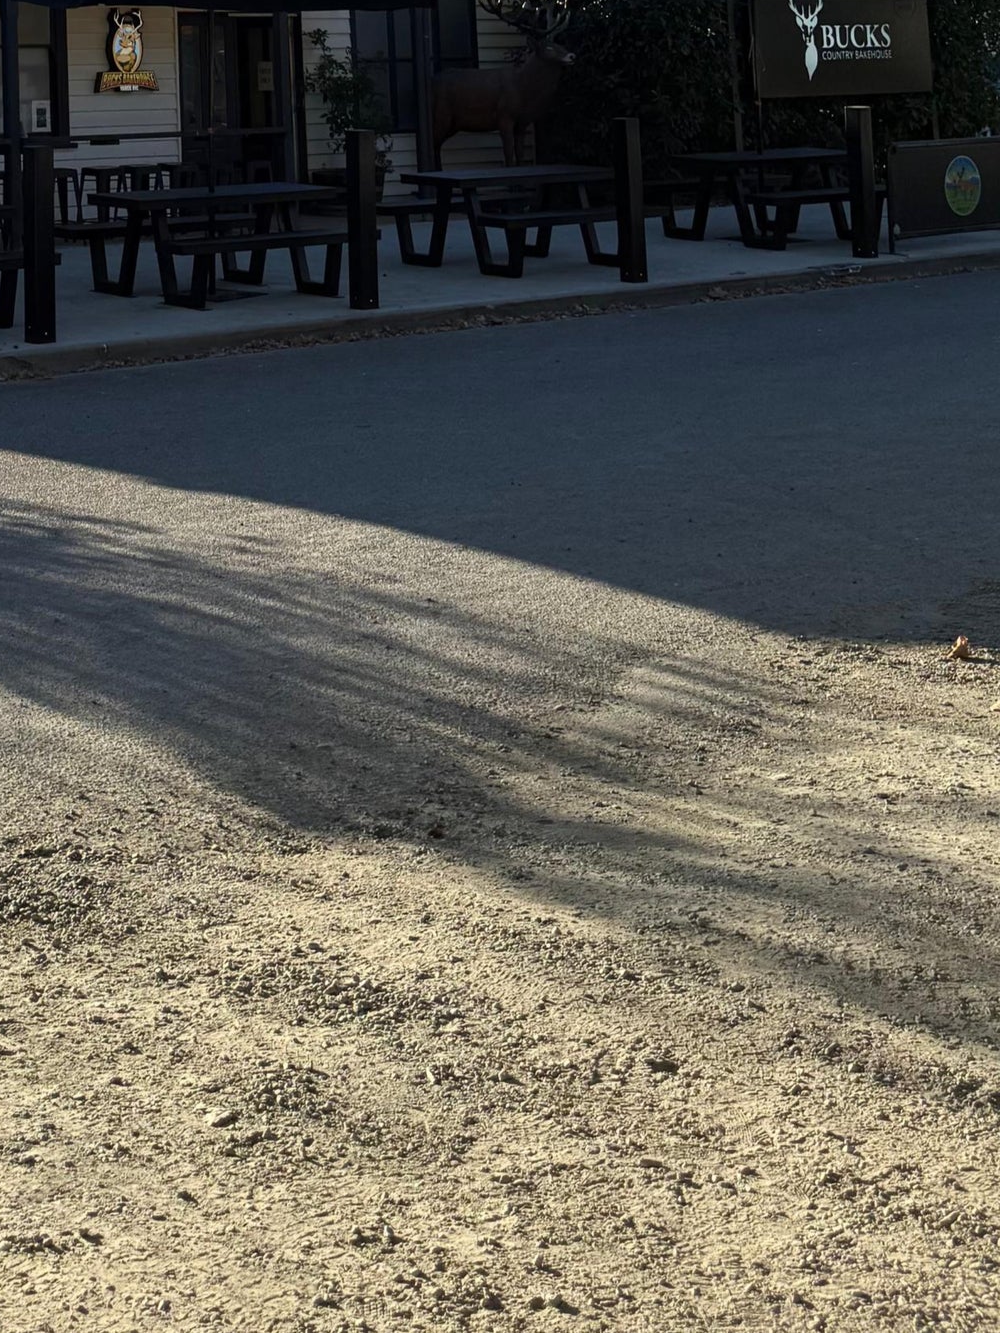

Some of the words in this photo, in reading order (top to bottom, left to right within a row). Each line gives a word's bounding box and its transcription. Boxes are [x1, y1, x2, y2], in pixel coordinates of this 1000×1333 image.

[820, 23, 892, 49] BUCKS
[822, 50, 853, 61] COUNTRY
[855, 49, 892, 60] BAKEHOUSE
